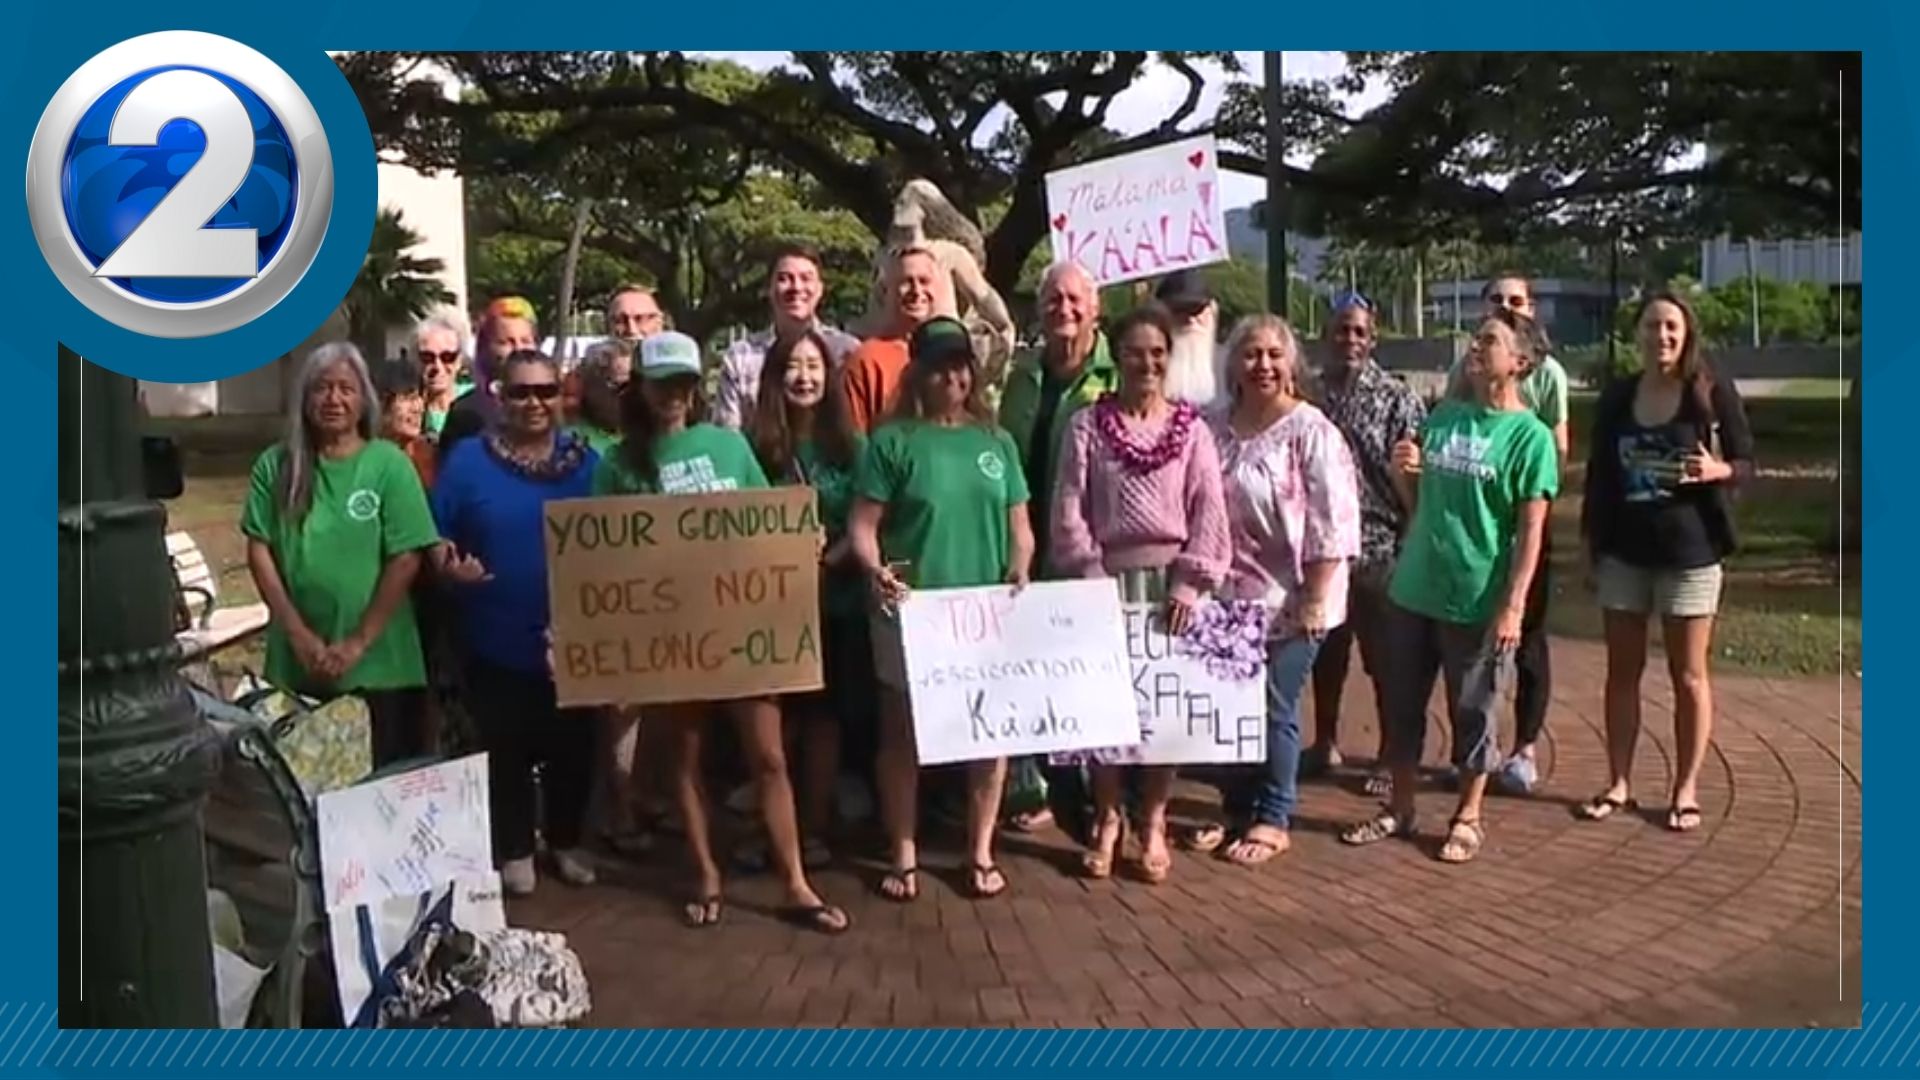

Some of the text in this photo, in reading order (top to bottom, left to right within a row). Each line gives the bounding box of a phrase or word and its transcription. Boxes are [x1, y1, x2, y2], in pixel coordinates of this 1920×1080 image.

[547, 503, 820, 555] YOUR GONDOLA
[579, 564, 799, 619] DOES NOT
[930, 591, 1016, 645] TOP
[565, 623, 820, 679] BELONG-OLA
